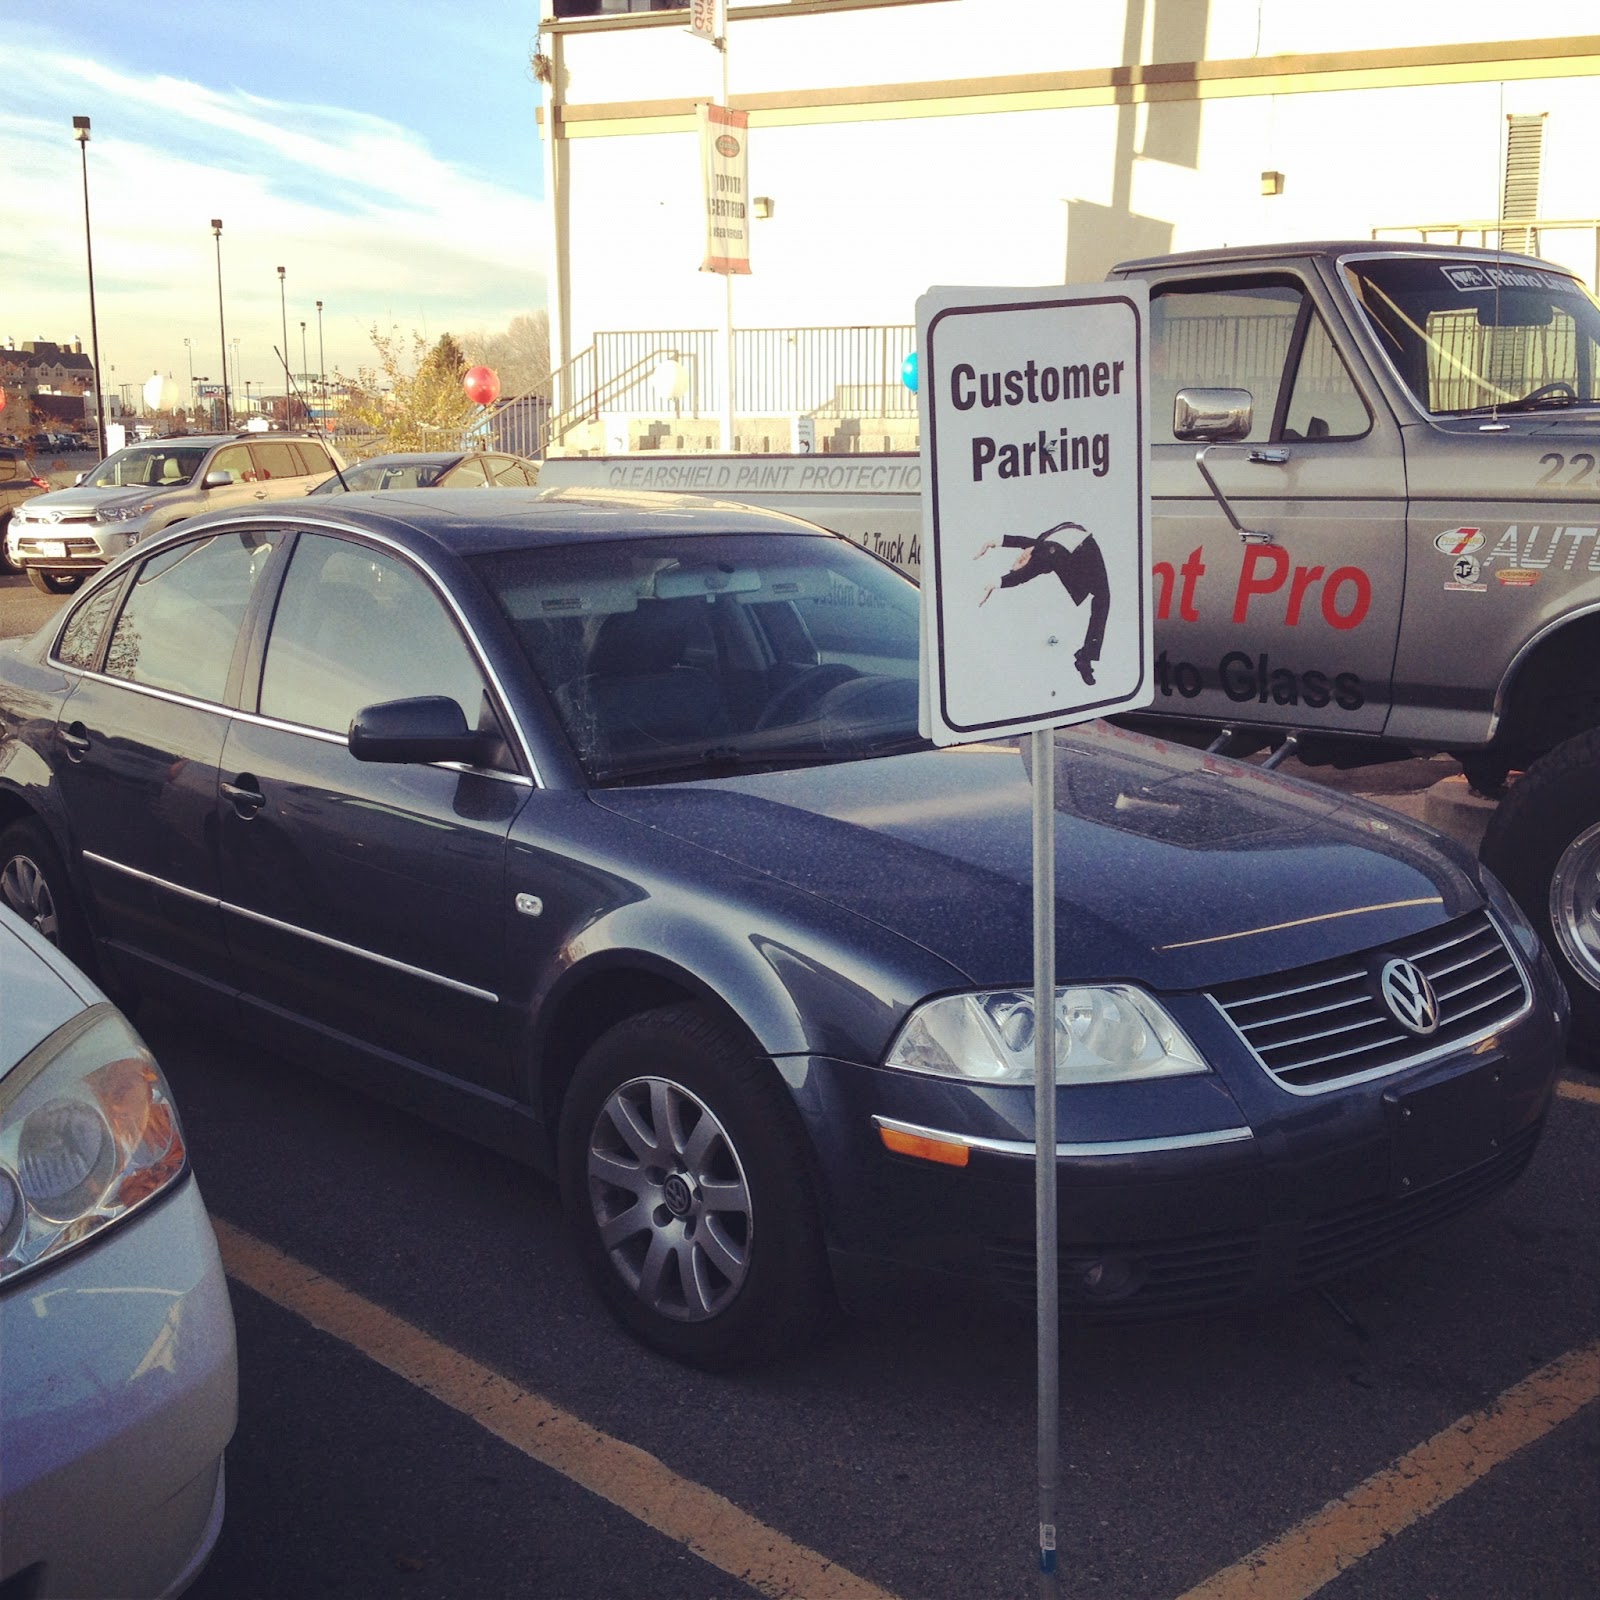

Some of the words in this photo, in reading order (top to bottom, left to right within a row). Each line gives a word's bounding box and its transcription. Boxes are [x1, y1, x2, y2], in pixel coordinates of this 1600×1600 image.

[694, 0, 705, 30] QU
[707, 197, 746, 219] CERTFIED
[1486, 268, 1543, 287] Rhino
[951, 360, 1124, 411] Customer
[972, 427, 1109, 482] Parking
[1534, 453, 1600, 490] 22
[609, 466, 731, 489] CLEARSHIELD
[736, 465, 794, 489] PAINT
[873, 532, 905, 564] Truck
[1232, 544, 1373, 631] Pro
[1219, 651, 1365, 711] Glass
